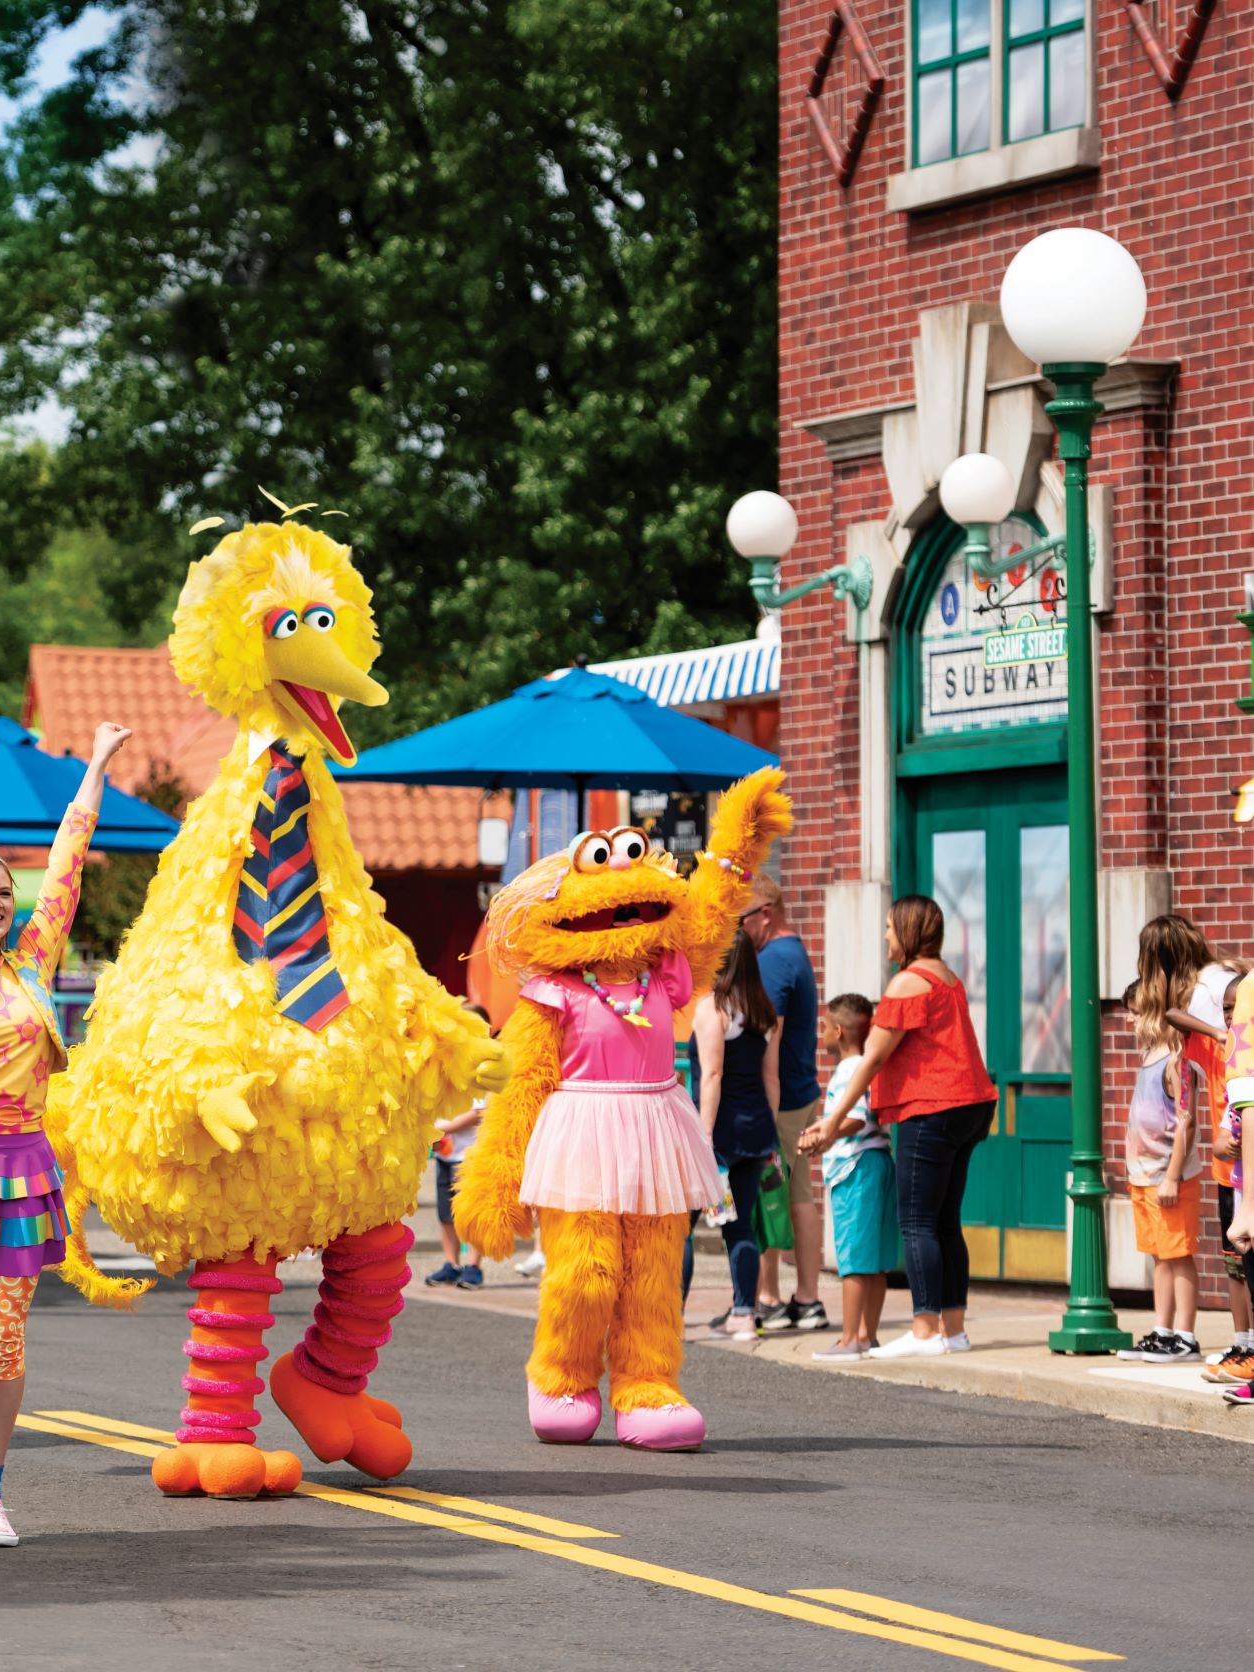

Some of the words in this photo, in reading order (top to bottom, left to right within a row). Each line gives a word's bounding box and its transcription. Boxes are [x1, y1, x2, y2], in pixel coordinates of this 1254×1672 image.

[946, 591, 956, 617] A
[987, 634, 1026, 663] SESAME
[1027, 629, 1064, 658] STREET
[946, 661, 1055, 698] SUBWAY
